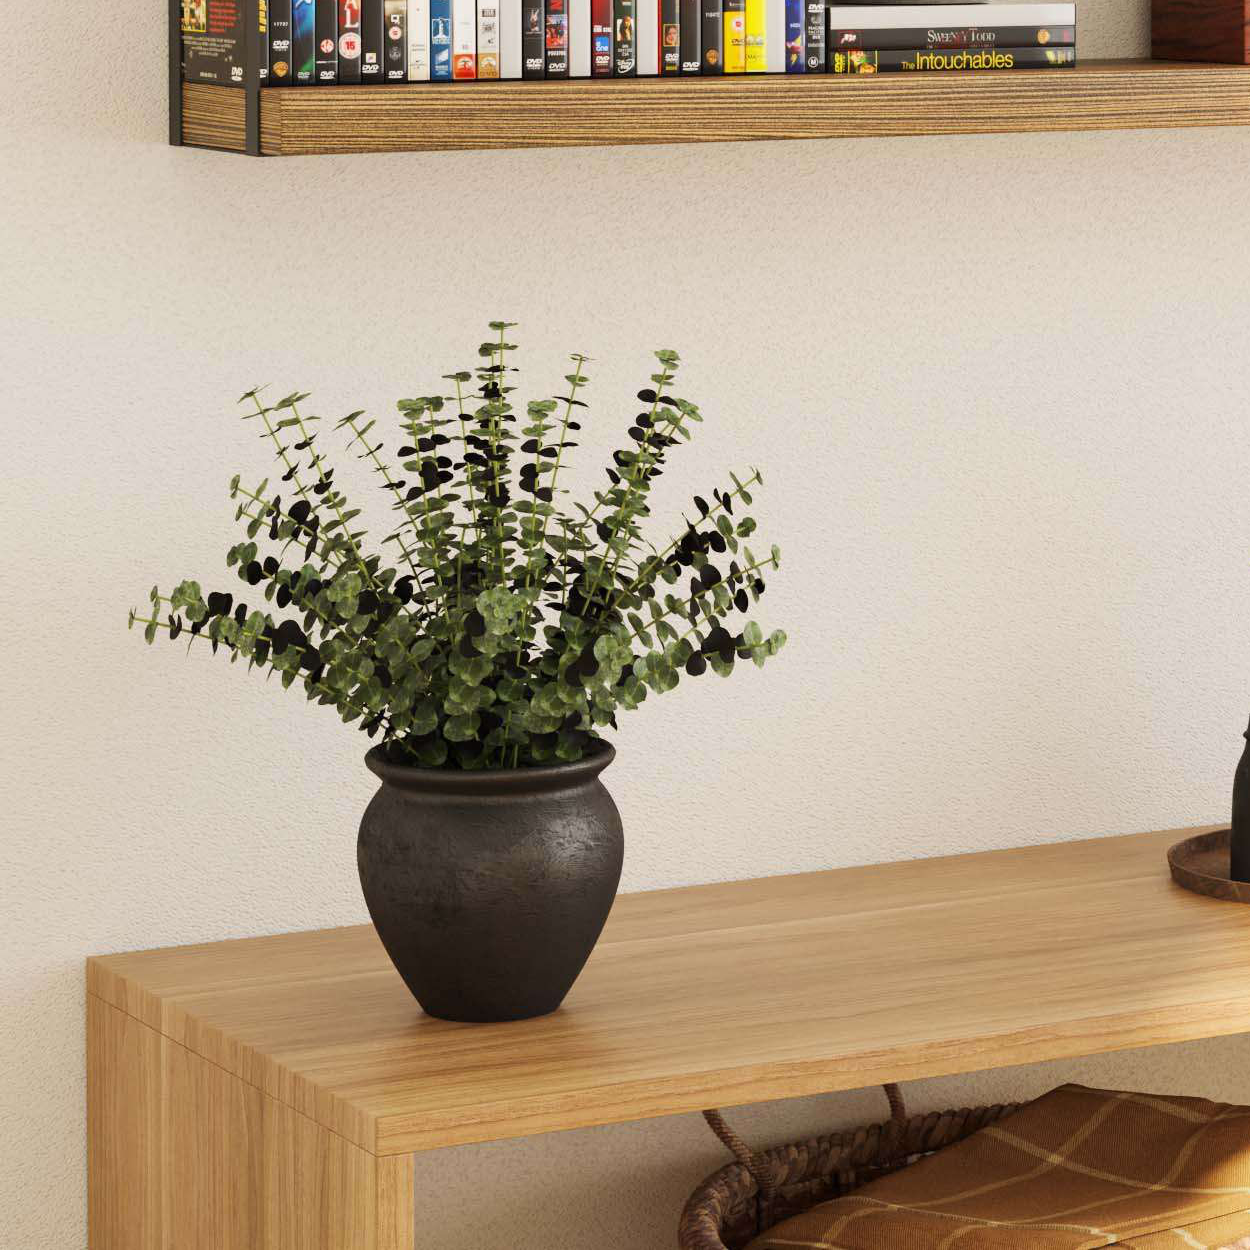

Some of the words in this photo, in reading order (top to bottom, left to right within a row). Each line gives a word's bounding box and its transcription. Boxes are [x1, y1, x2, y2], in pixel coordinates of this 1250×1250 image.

[808, 4, 824, 12] DVD
[969, 27, 996, 42] TODD
[345, 41, 355, 51] 15
[901, 61, 915, 70] The
[916, 50, 1013, 70] Intouchables
[362, 65, 379, 73] DVD
[548, 62, 566, 71] DVD
[682, 61, 700, 70] DVD
